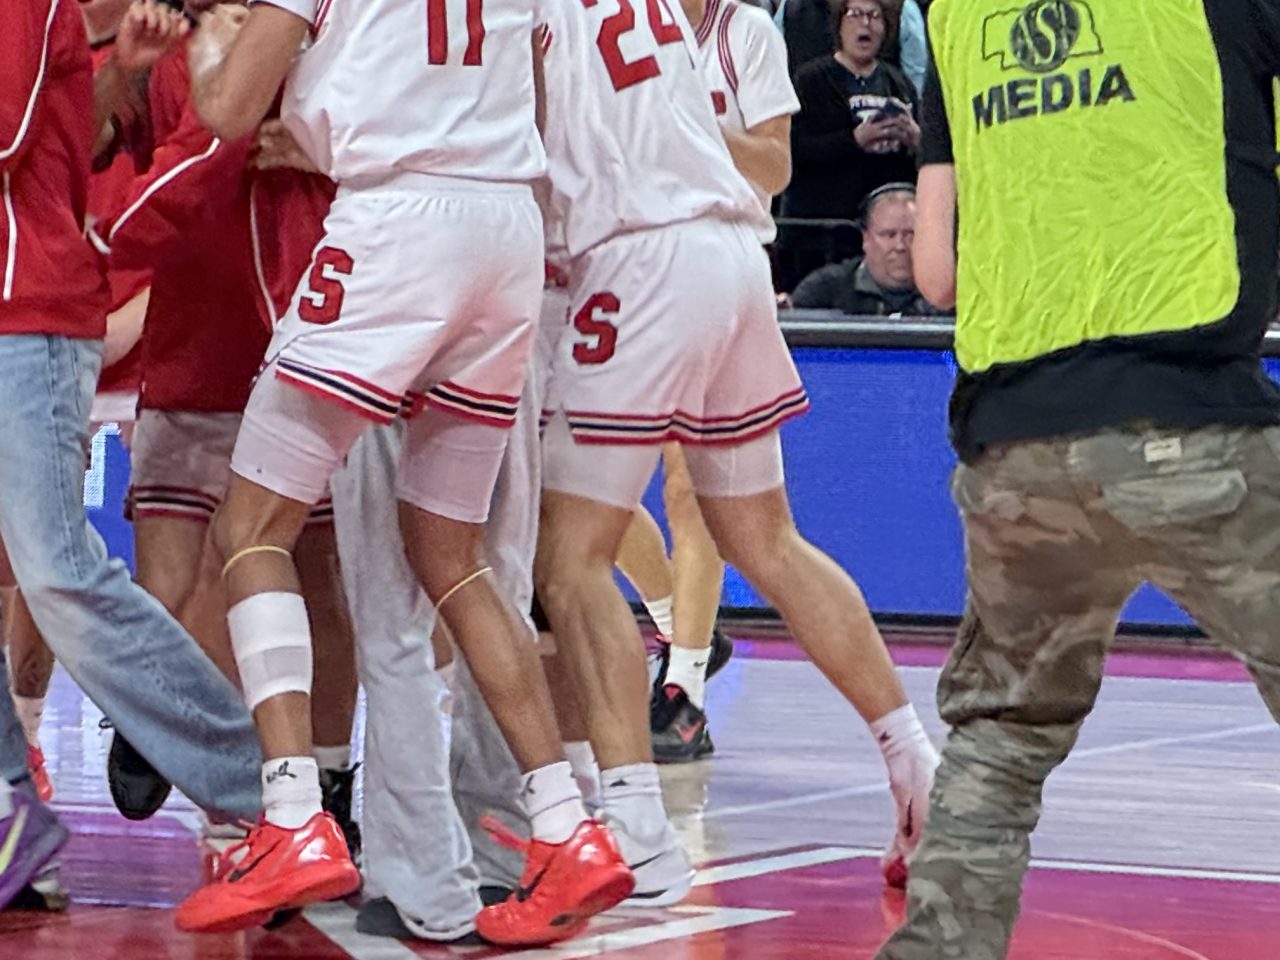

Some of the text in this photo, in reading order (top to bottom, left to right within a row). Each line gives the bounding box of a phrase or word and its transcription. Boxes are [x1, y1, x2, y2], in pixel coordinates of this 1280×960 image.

[972, 63, 1136, 136] MEDIA
[298, 245, 355, 326] S
[572, 292, 621, 366] S
